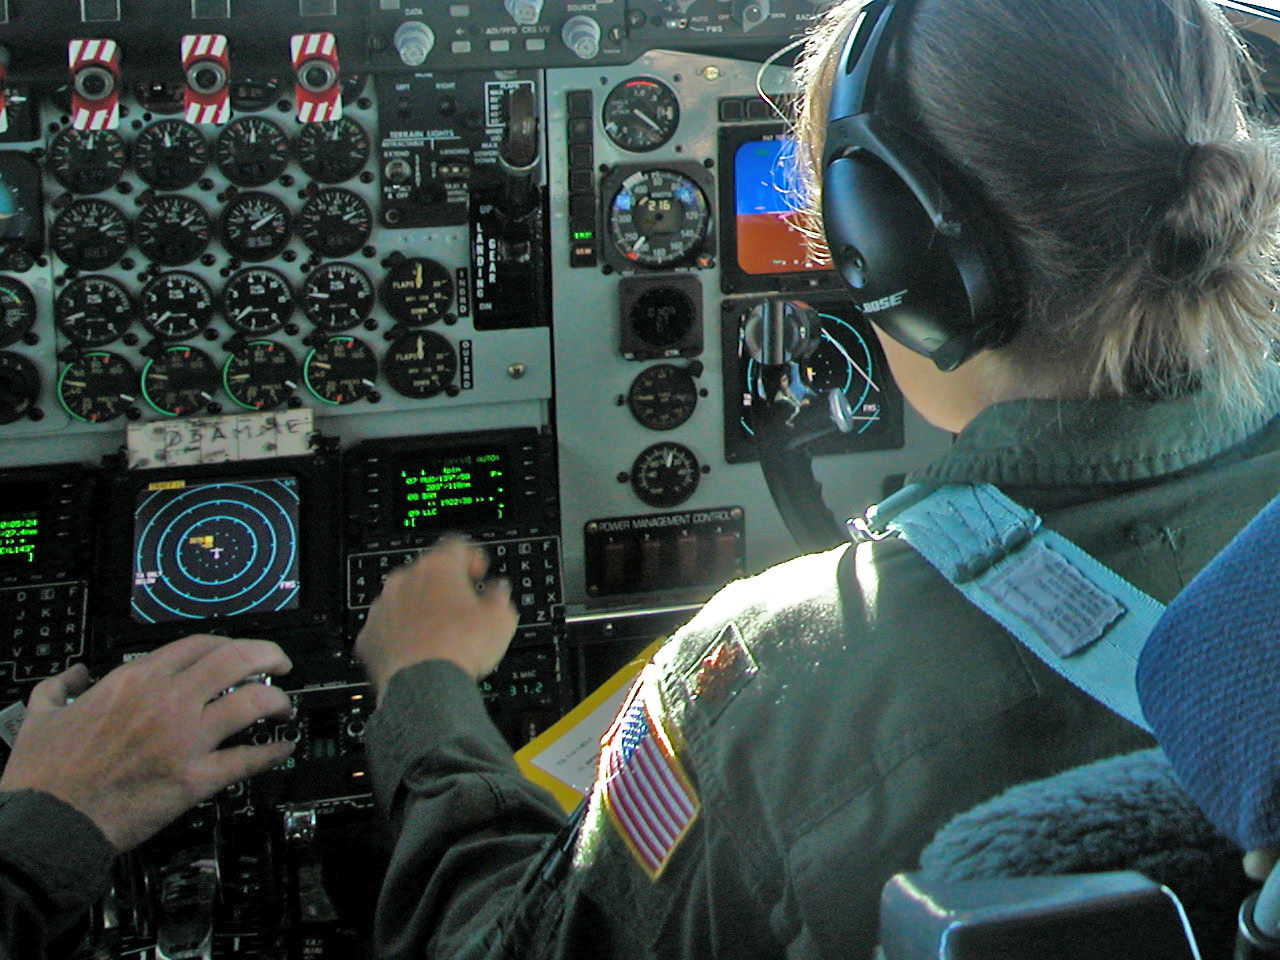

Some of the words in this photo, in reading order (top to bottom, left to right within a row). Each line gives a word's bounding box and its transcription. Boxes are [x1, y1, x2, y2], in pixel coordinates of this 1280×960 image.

[404, 8, 424, 17] DATA
[566, 4, 598, 13] SOURCE
[389, 130, 424, 139] TERRAIN
[427, 129, 455, 138] LIGHTS
[648, 199, 671, 211] 216
[476, 222, 484, 298] LANDING
[488, 238, 496, 284] GEAR
[392, 281, 414, 289] FLAPS
[861, 290, 908, 313] BOSE
[598, 520, 631, 533] POWER
[632, 514, 692, 530] MANAGEMENT
[692, 510, 732, 524] CONTROL
[497, 545, 506, 556] D
[521, 561, 531, 571] K
